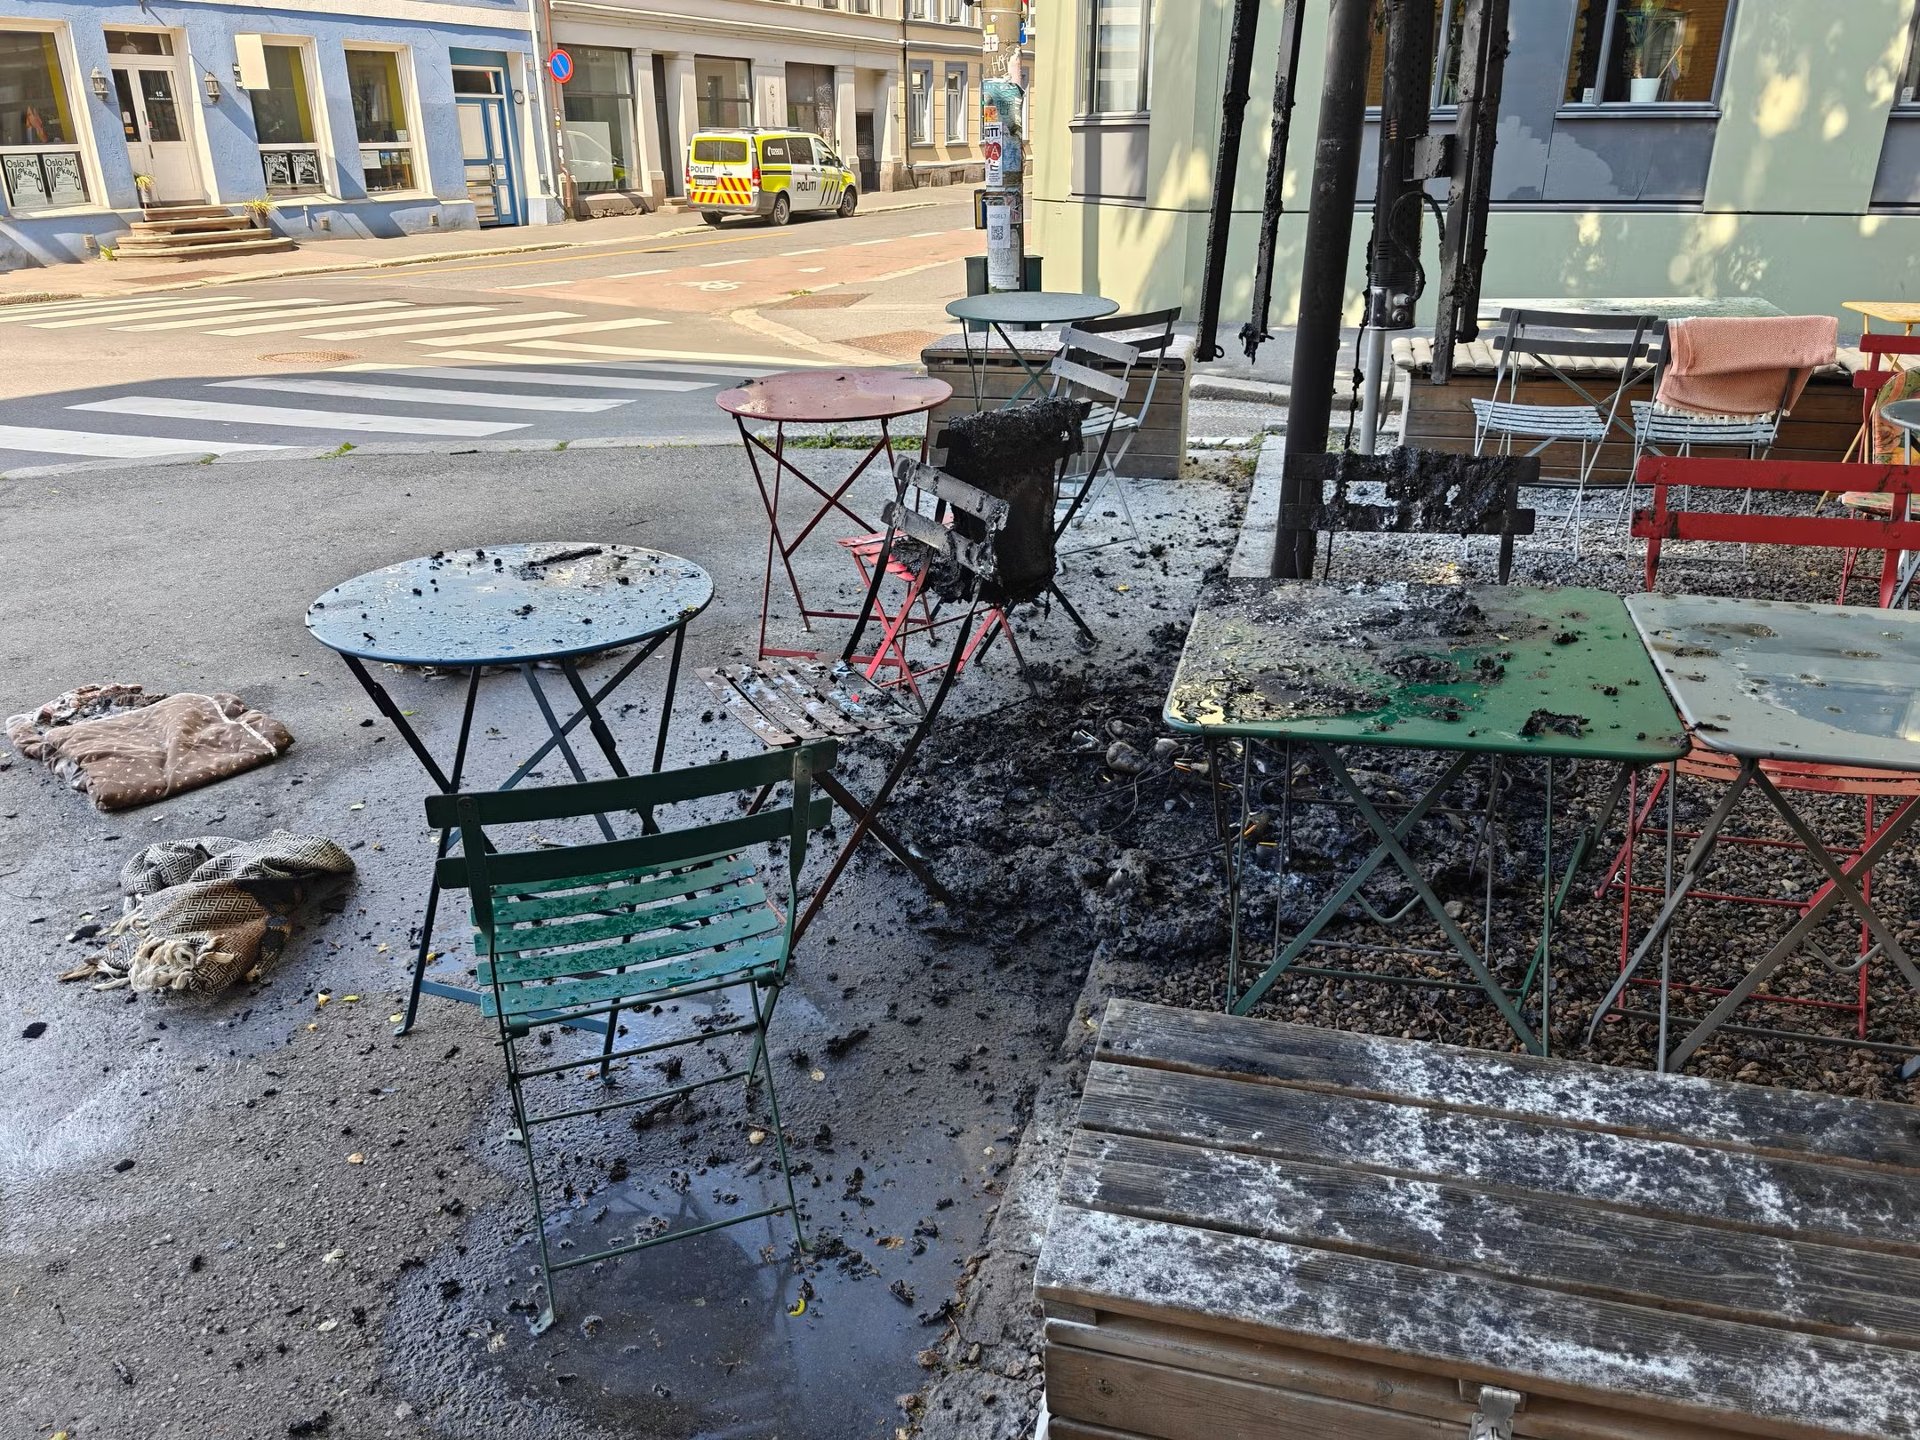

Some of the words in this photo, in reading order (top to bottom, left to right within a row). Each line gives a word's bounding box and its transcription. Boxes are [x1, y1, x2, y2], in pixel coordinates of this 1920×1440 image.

[6, 160, 24, 168] Oslo
[26, 159, 38, 167] Art
[45, 158, 63, 167] Oslo
[64, 157, 76, 166] Art
[796, 181, 817, 192] POLITI
